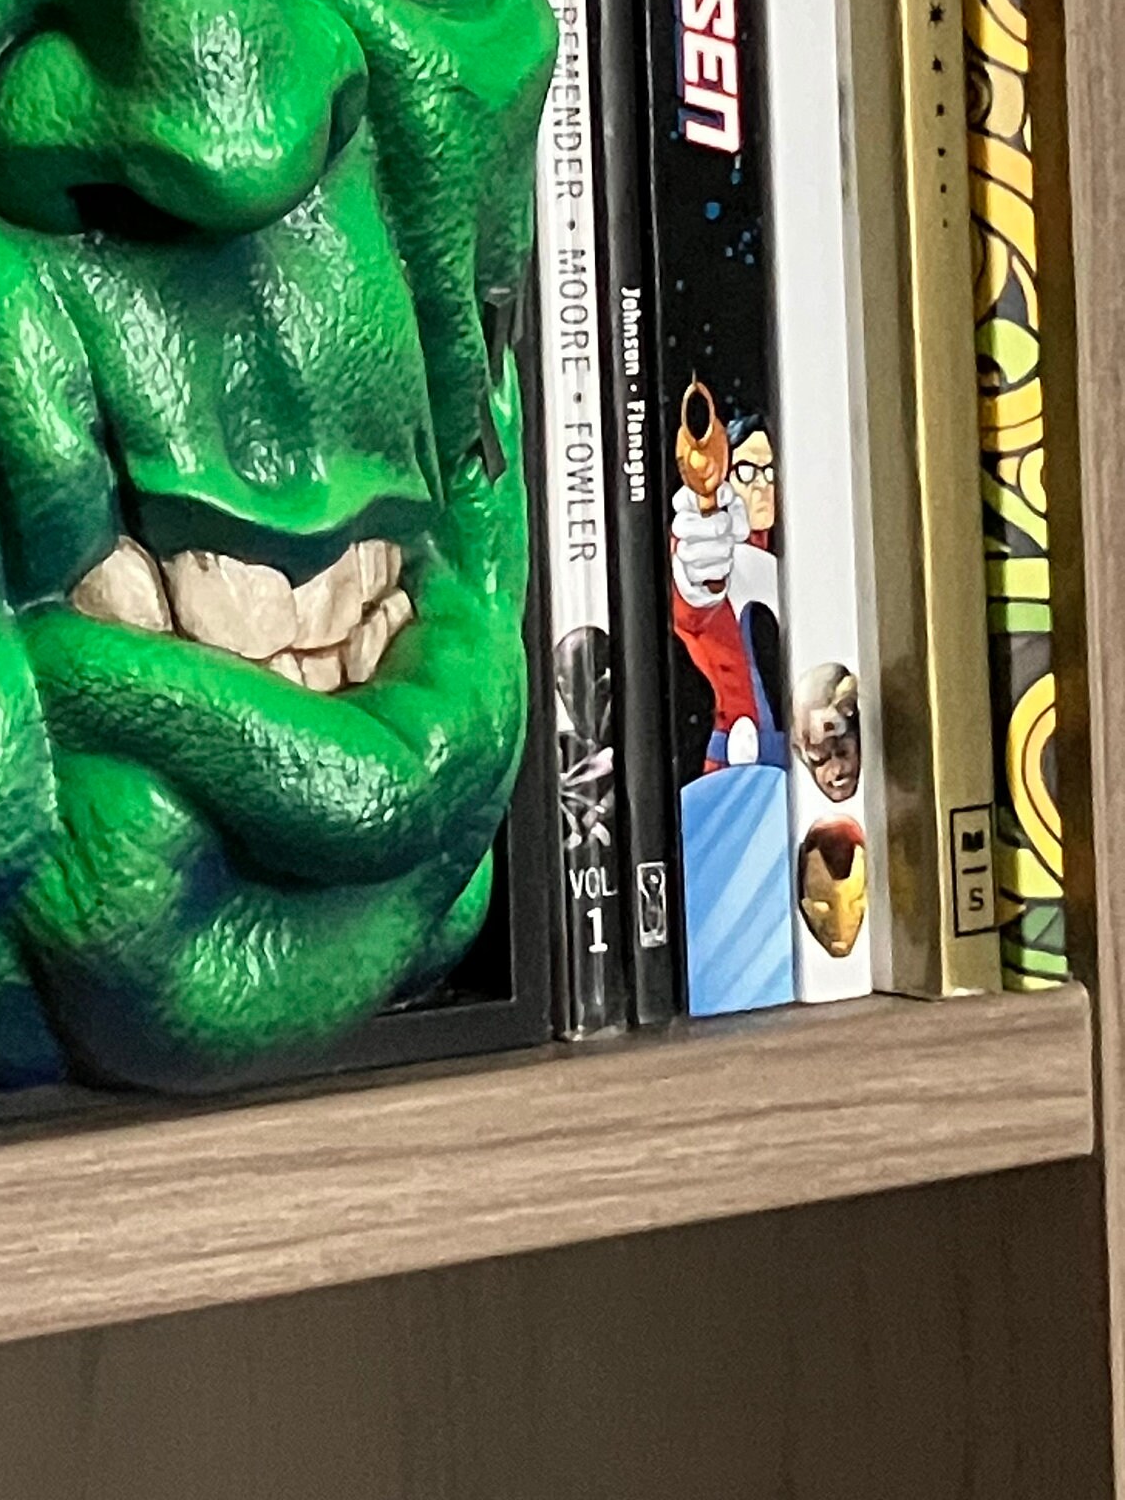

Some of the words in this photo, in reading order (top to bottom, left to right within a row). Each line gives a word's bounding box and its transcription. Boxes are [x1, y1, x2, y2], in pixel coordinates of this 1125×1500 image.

[557, 247, 591, 375] MOORE
[620, 286, 643, 377] Johnson
[564, 421, 598, 564] FOWLER
[621, 399, 646, 503] Flanagan
[586, 907, 610, 954] 1
